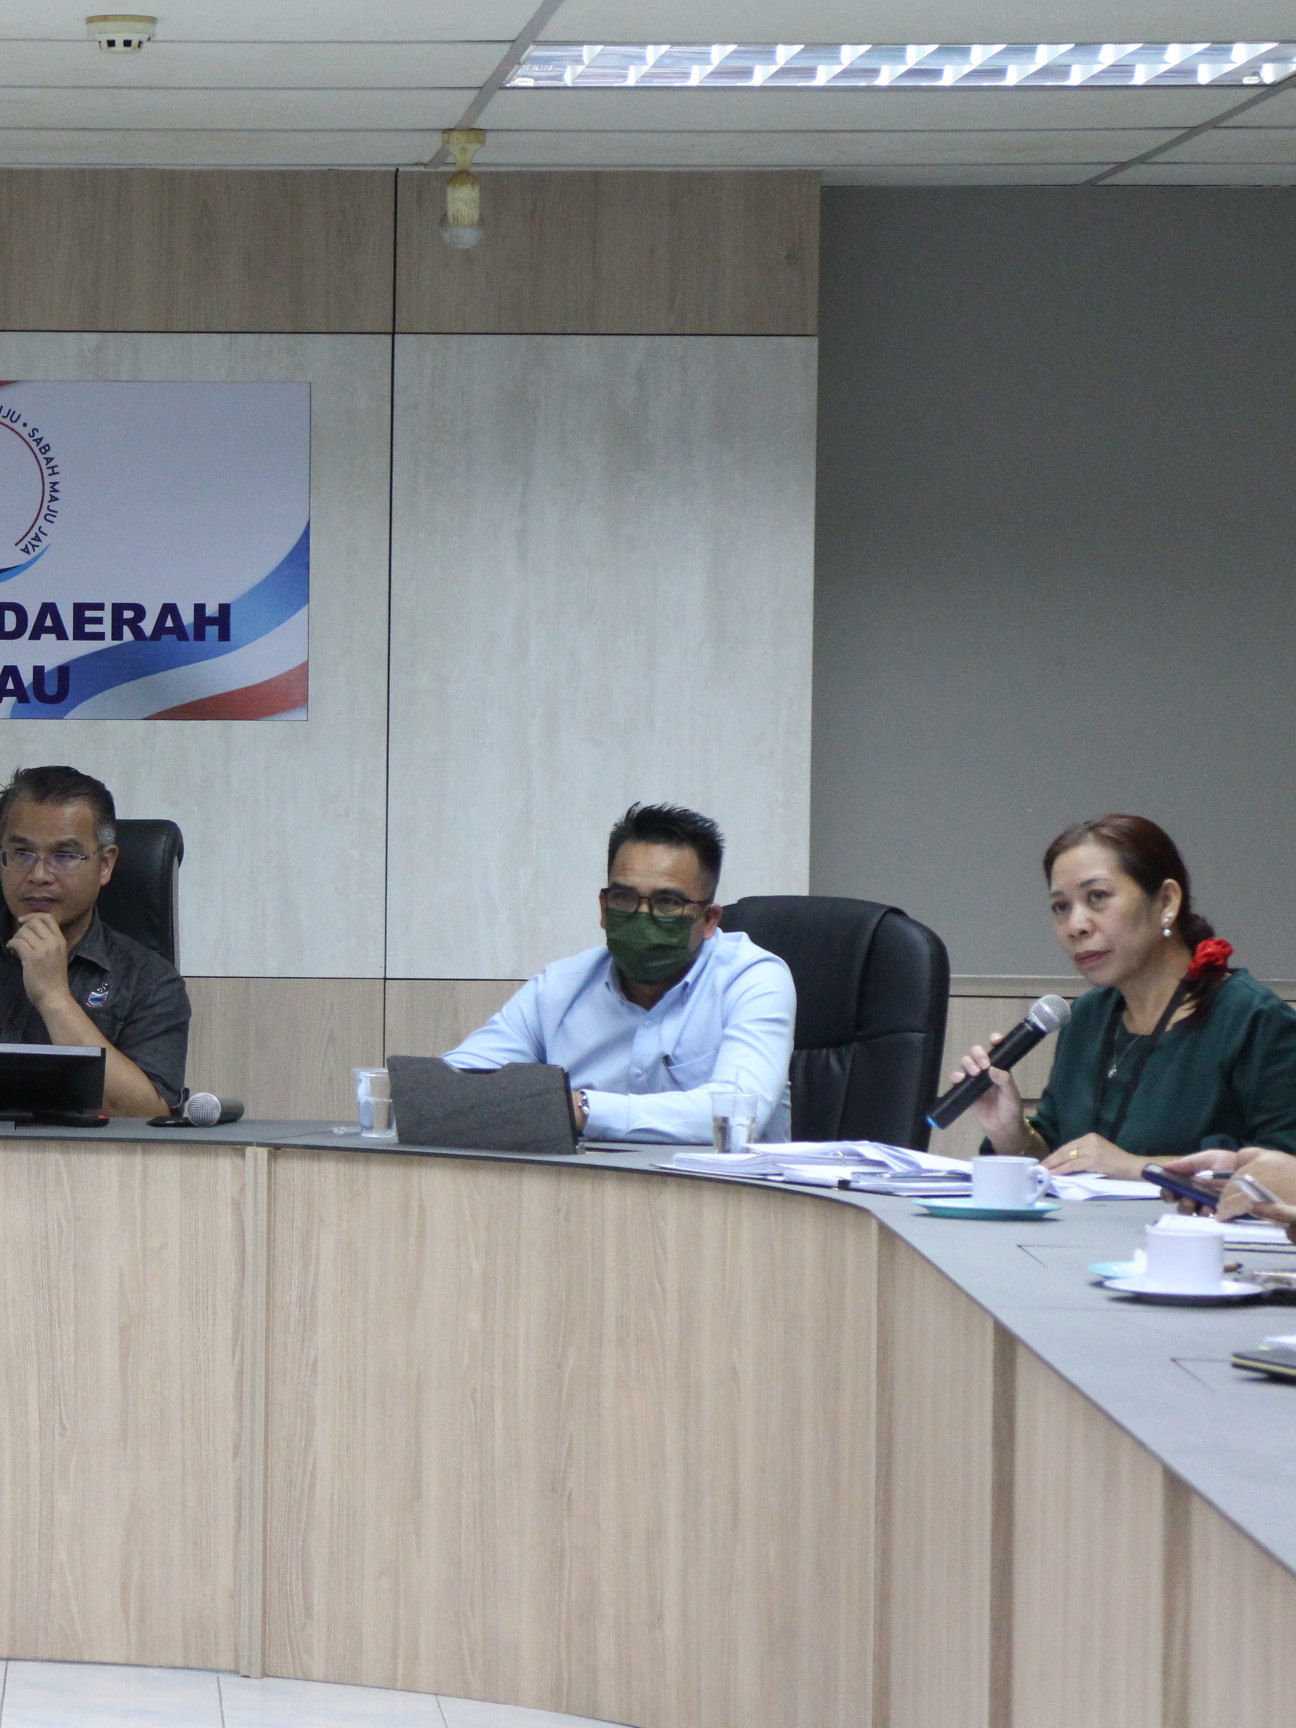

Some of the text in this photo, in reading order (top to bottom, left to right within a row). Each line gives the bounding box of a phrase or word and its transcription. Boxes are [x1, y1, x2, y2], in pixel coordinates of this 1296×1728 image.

[27, 427, 60, 477] SABAH
[43, 481, 61, 525] MAJU
[19, 525, 49, 556] JAYA
